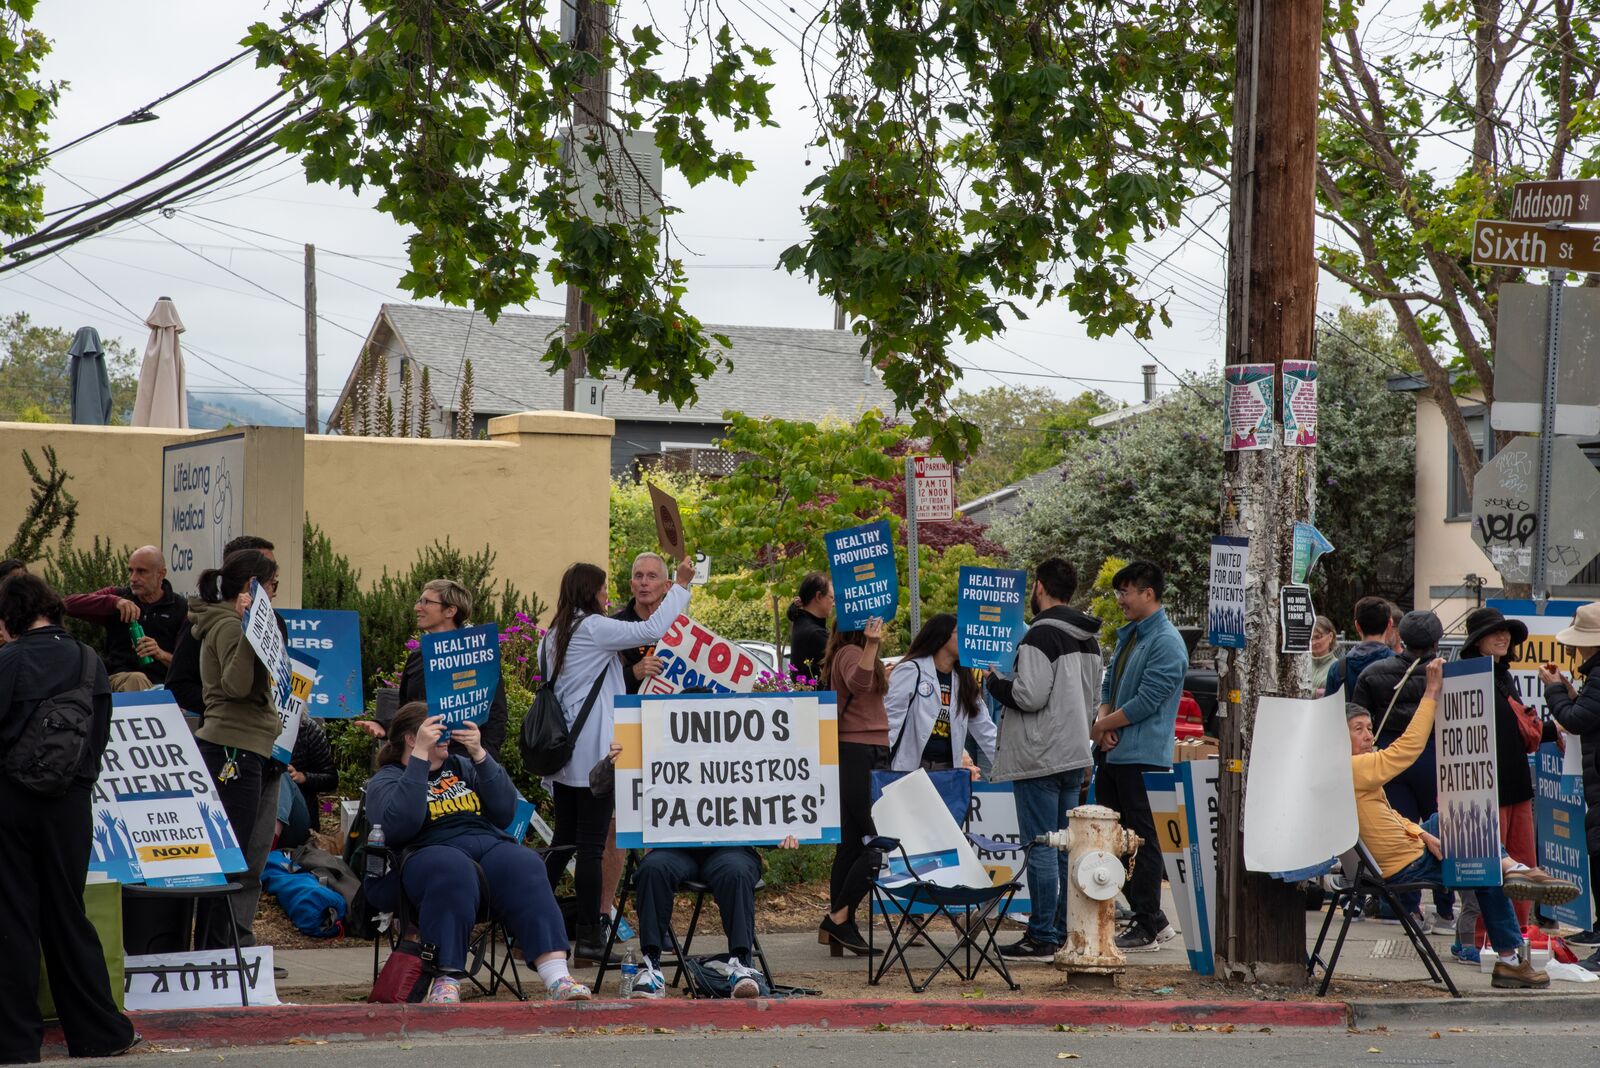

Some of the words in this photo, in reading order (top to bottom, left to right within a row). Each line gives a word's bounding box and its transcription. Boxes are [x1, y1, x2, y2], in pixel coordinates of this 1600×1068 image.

[1512, 187, 1573, 218] Addison
[1579, 193, 1590, 210] St
[1477, 227, 1547, 263] Sixth
[1559, 242, 1574, 259] St
[173, 462, 210, 495] LifeLong
[918, 480, 922, 488] 9
[926, 480, 936, 488] AM
[939, 480, 946, 488] TO
[918, 489, 925, 497] 12
[928, 488, 948, 496] NOON
[172, 501, 206, 532] Medical
[932, 504, 950, 512] MONTH
[836, 530, 880, 550] HEALTHY
[171, 543, 193, 573] Care
[833, 544, 888, 566] PROVIDERS
[1216, 552, 1242, 568] UNITED
[969, 574, 1015, 588] HEALTHY
[1214, 570, 1228, 585] FOR
[1229, 570, 1242, 586] OUR
[844, 580, 888, 600] HEALTHY
[963, 588, 1020, 603] PROVIDERS
[1211, 587, 1244, 603] PATIENTS
[844, 593, 892, 613] PATIENTS
[253, 599, 268, 639] UNITED
[966, 624, 1012, 638] HEALTHY
[260, 630, 271, 656] FOR
[434, 633, 487, 656] HEALTHY
[662, 613, 753, 684] STOP
[964, 638, 1013, 653] PATIENTS
[430, 650, 494, 672] PROVIDERS
[439, 688, 489, 710] HEALTHY
[1444, 688, 1484, 722] UNITED
[440, 700, 489, 725] PATIENTS
[110, 717, 167, 742] TED
[670, 709, 790, 743] UNIDOS
[1442, 728, 1462, 757] FOR
[1466, 725, 1490, 756] OUR
[128, 744, 188, 769] OUR
[652, 761, 692, 785] POR
[700, 758, 810, 784] NUESTROS
[1440, 760, 1494, 794] PATIENTS
[92, 771, 209, 804] ATIENTS
[146, 812, 180, 825] FAIR
[652, 794, 818, 828] PACIENTES
[132, 827, 204, 843] CONTRACT
[152, 846, 200, 857] NOW
[1545, 841, 1580, 868] HEALTHY
